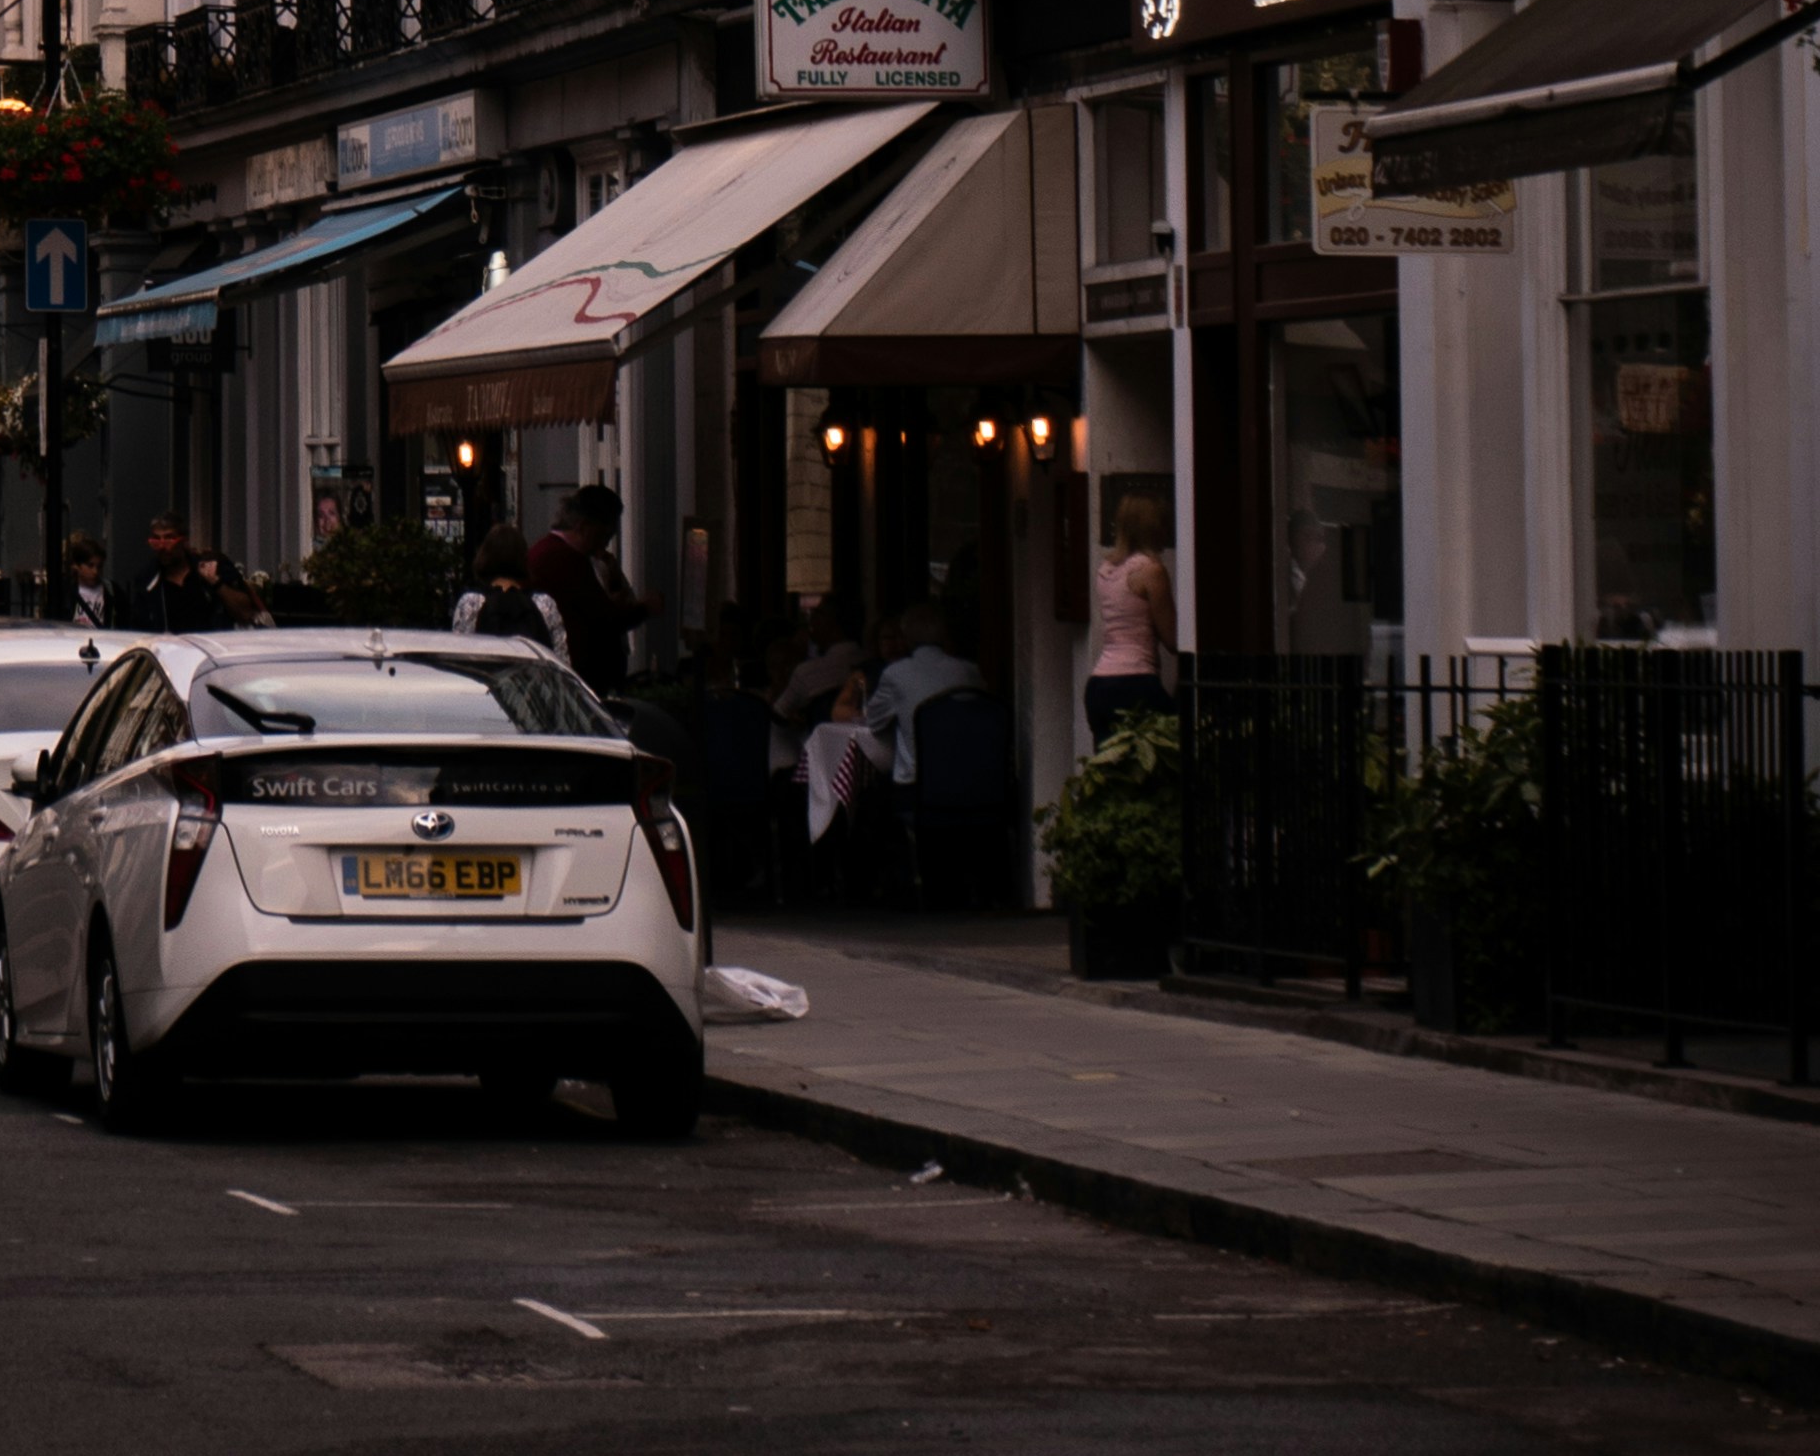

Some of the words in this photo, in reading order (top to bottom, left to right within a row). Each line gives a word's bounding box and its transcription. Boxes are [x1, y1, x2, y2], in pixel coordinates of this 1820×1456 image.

[831, 6, 921, 33] Italian
[810, 38, 947, 66] Restaurant
[797, 70, 849, 86] FULLY
[875, 70, 961, 87] LICENSED
[1330, 226, 1370, 247] 020
[1390, 226, 1443, 247] 7402
[170, 350, 213, 366] group
[252, 777, 316, 798] Swift
[322, 777, 378, 797] Cars
[260, 825, 300, 836] TOYOTA
[554, 828, 604, 838] PRIUS
[363, 860, 446, 889] LM66
[455, 861, 516, 890] EBP
